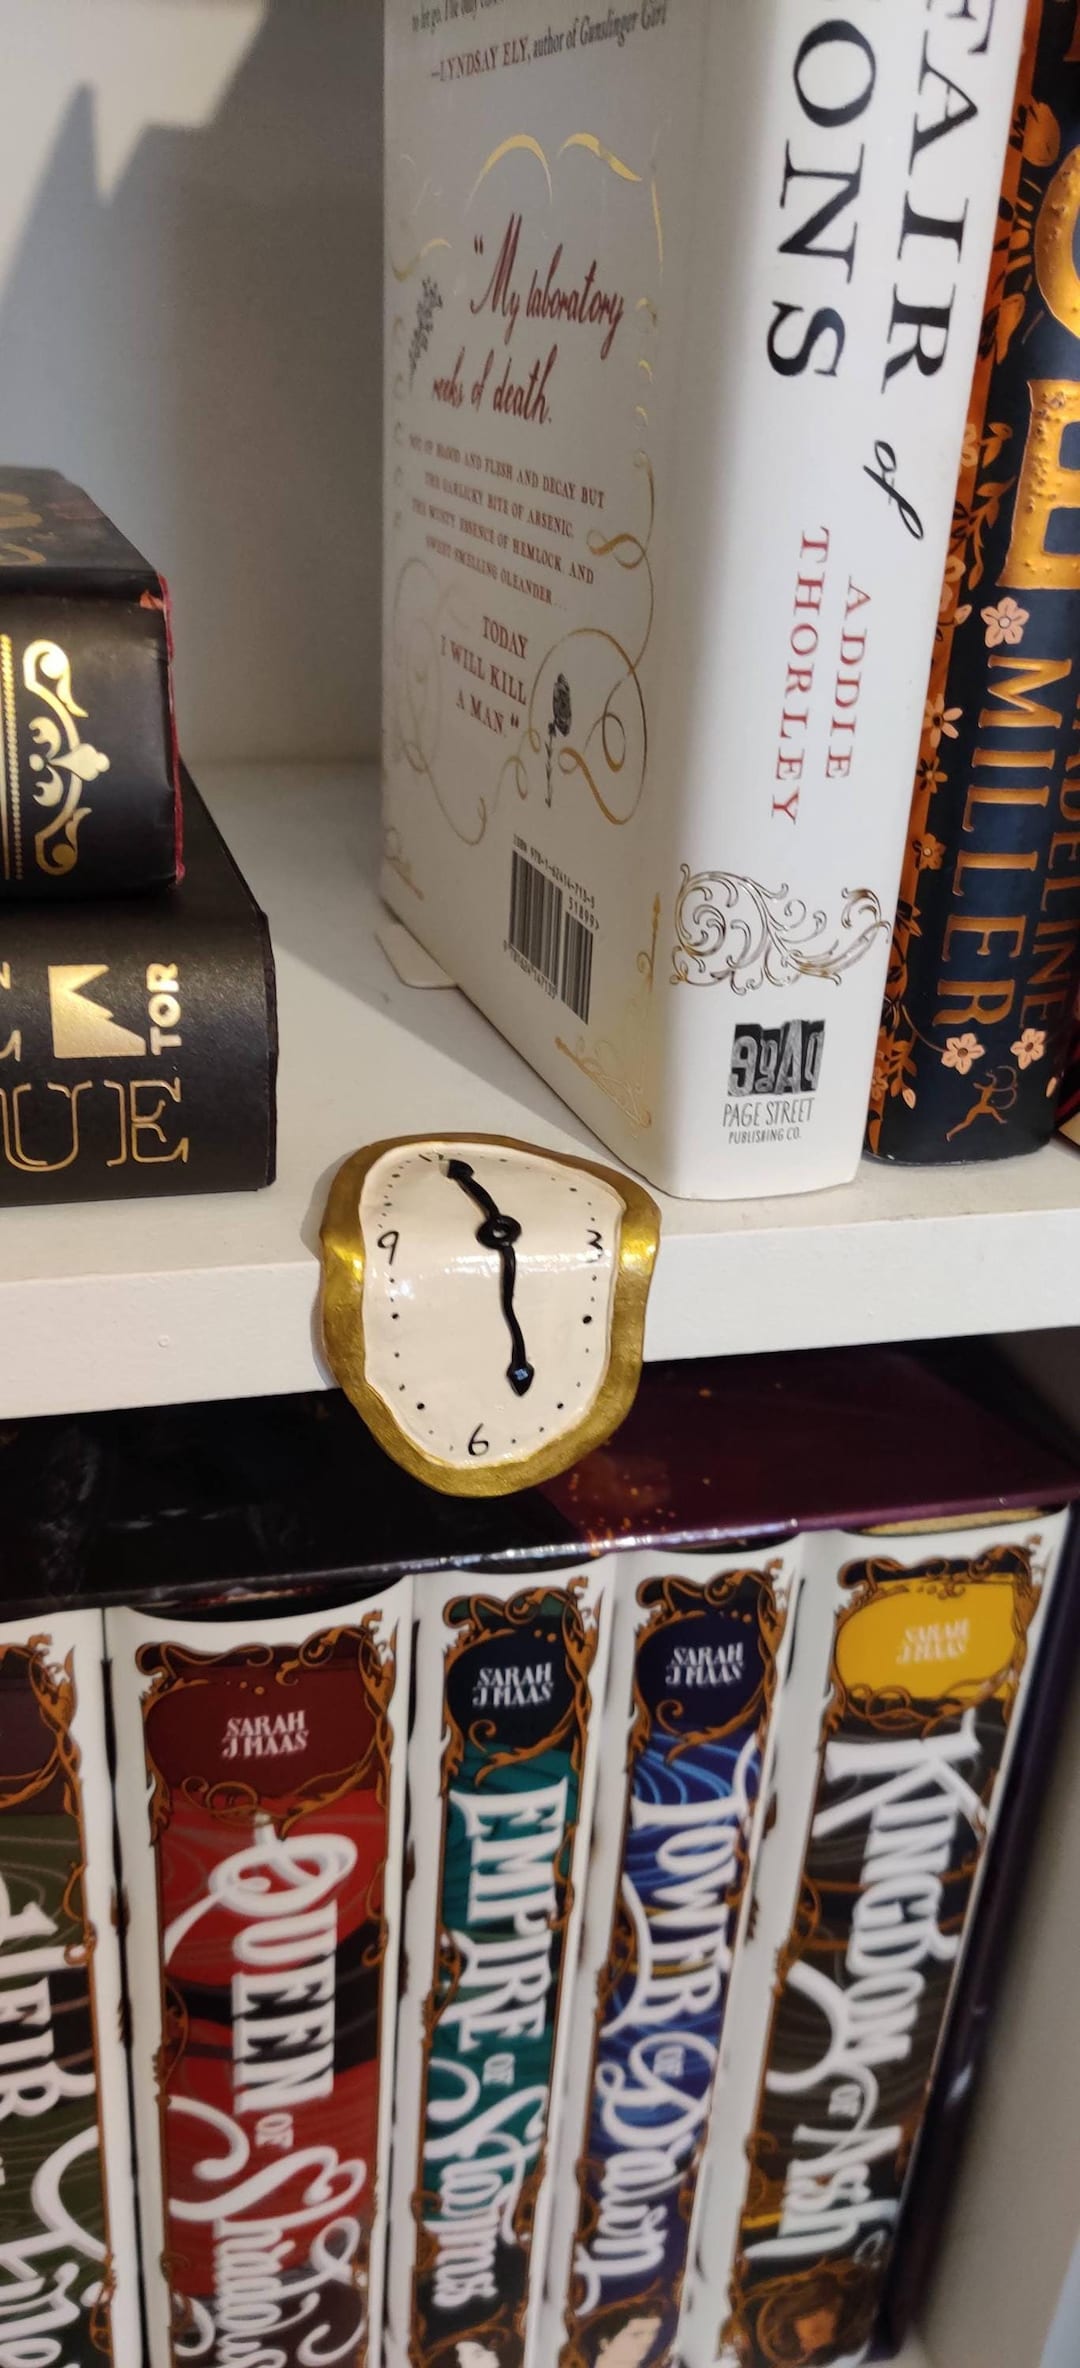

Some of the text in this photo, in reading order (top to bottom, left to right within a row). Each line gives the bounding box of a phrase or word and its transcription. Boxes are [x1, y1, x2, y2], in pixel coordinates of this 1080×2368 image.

[566, 17, 579, 50] of
[767, 20, 877, 377] ONS
[526, 243, 624, 360] laboratory
[471, 350, 494, 413] of
[493, 344, 557, 425] death.
[464, 452, 482, 471] AND
[485, 458, 513, 481] FLESH
[517, 469, 539, 489] AND
[543, 476, 576, 501] DECAY
[581, 486, 605, 509] BUT
[862, 440, 924, 540] of
[487, 494, 509, 515] BITE
[512, 502, 524, 519] OF
[497, 532, 509, 548] OF
[512, 537, 562, 573] HEMLOCK
[569, 562, 594, 584] AND
[483, 615, 529, 660] TODAY
[449, 640, 485, 681] WILL
[489, 663, 526, 706] KILL
[771, 525, 830, 825] THORLEY
[826, 575, 873, 779] ADDIE
[456, 688, 465, 711] A
[933, 654, 1072, 1027] MILLER
[146, 963, 182, 1056] TOR
[722, 1097, 815, 1127] PAGE STREET
[728, 1128, 784, 1144] PUBLISHING
[377, 1231, 399, 1265] 9
[586, 1230, 604, 1263] 3
[467, 1423, 490, 1456] 6
[477, 1662, 552, 1688] SARAH
[671, 1642, 744, 1668] SARAH
[684, 1661, 745, 1687] MAAS
[472, 1680, 554, 1707] J MAAS
[222, 1710, 305, 1742] SARAH
[222, 1730, 309, 1758] J MAAS
[600, 1732, 758, 2038] TOWER
[438, 1776, 569, 2054] EMPIRE
[163, 1812, 359, 2115] QUEEN
[482, 2052, 516, 2087] OF
[254, 2113, 294, 2149] OF
[574, 2031, 718, 2317] Dawn
